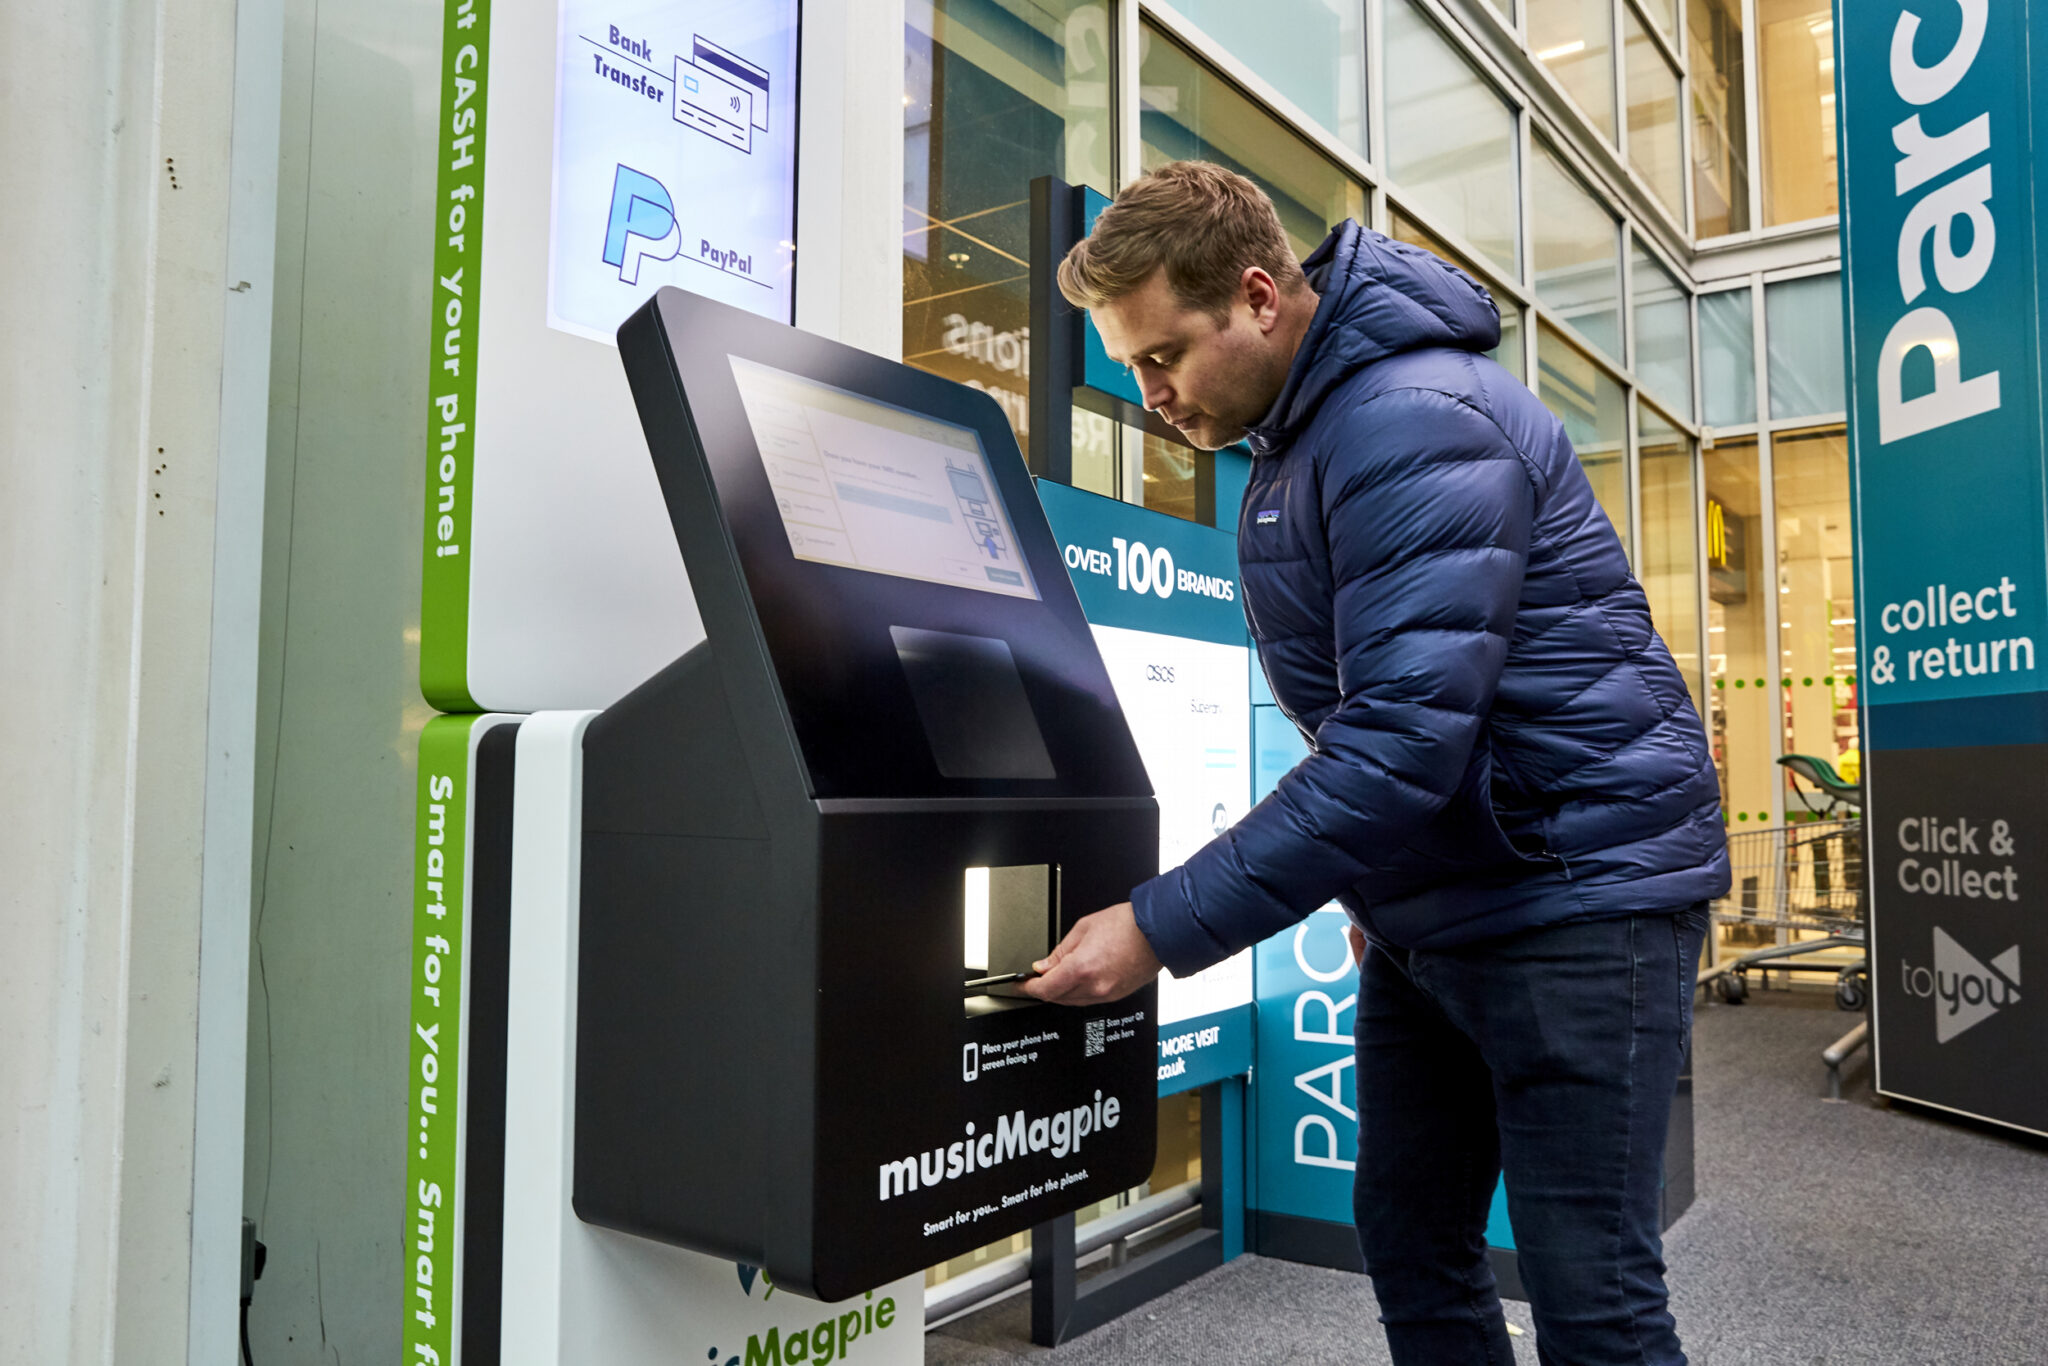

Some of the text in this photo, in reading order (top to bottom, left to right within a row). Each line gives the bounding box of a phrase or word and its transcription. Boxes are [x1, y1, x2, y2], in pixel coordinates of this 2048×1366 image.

[609, 24, 652, 62] Bank
[452, 44, 478, 171] CASH
[593, 53, 664, 103] Transfer
[449, 184, 475, 252] for
[701, 239, 752, 275] PayPal
[440, 267, 464, 377] your
[435, 393, 466, 558] phone!
[1065, 536, 1234, 601] OVER 100 BRANDS
[1881, 576, 2017, 634] collect
[1870, 636, 2035, 685] & return
[426, 774, 454, 920] Smart
[1898, 816, 2015, 856] Click &
[1898, 858, 2019, 901] Collect
[424, 935, 450, 1007] for
[982, 1043, 1001, 1055] Place
[1002, 1040, 1019, 1053] your
[1020, 1035, 1041, 1049] phone
[1106, 1011, 1145, 1028] Scan your QR
[1106, 1029, 1135, 1042] code here
[1161, 1026, 1220, 1058] MORE VISIT
[1293, 902, 1357, 1171] PARC
[416, 1022, 439, 1160] you...
[982, 1052, 1038, 1071] screen facing up
[879, 1089, 1121, 1201] musicMagpie
[923, 1168, 1089, 1237] Smart for you... Smart for the planet.
[415, 1178, 442, 1329] Smart
[708, 1290, 896, 1366] Magpie
